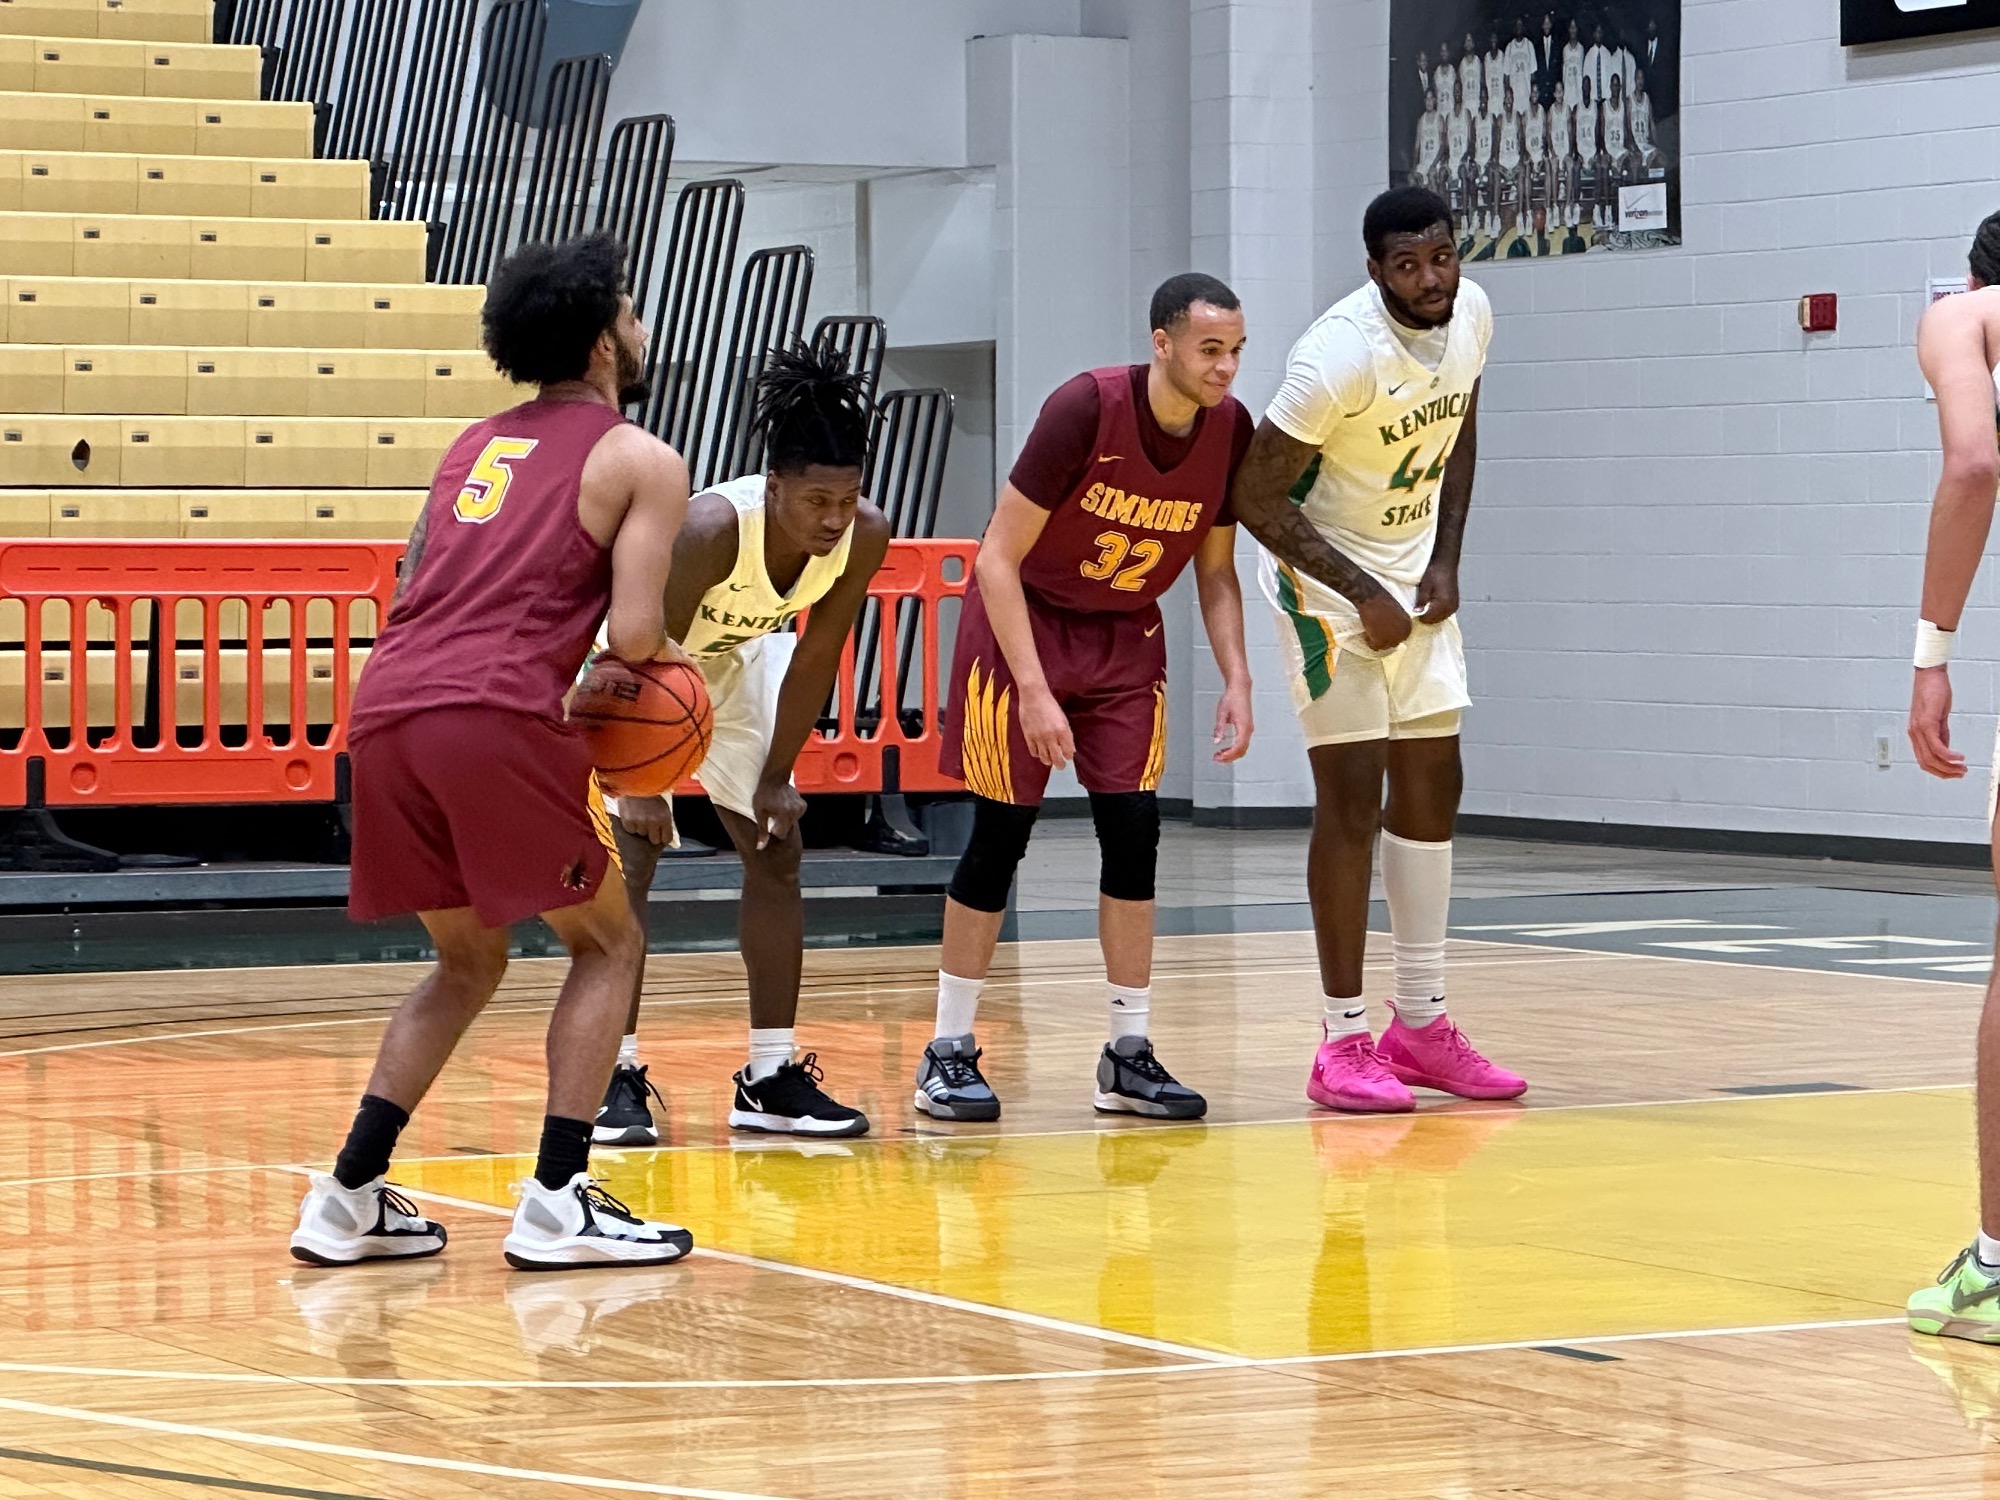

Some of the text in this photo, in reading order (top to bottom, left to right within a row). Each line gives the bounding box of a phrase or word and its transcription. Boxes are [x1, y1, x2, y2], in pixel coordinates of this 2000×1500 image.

[452, 435, 540, 525] 5
[1080, 481, 1203, 533] SIMMONS
[1381, 493, 1432, 527] STATE
[1079, 530, 1164, 592] 32
